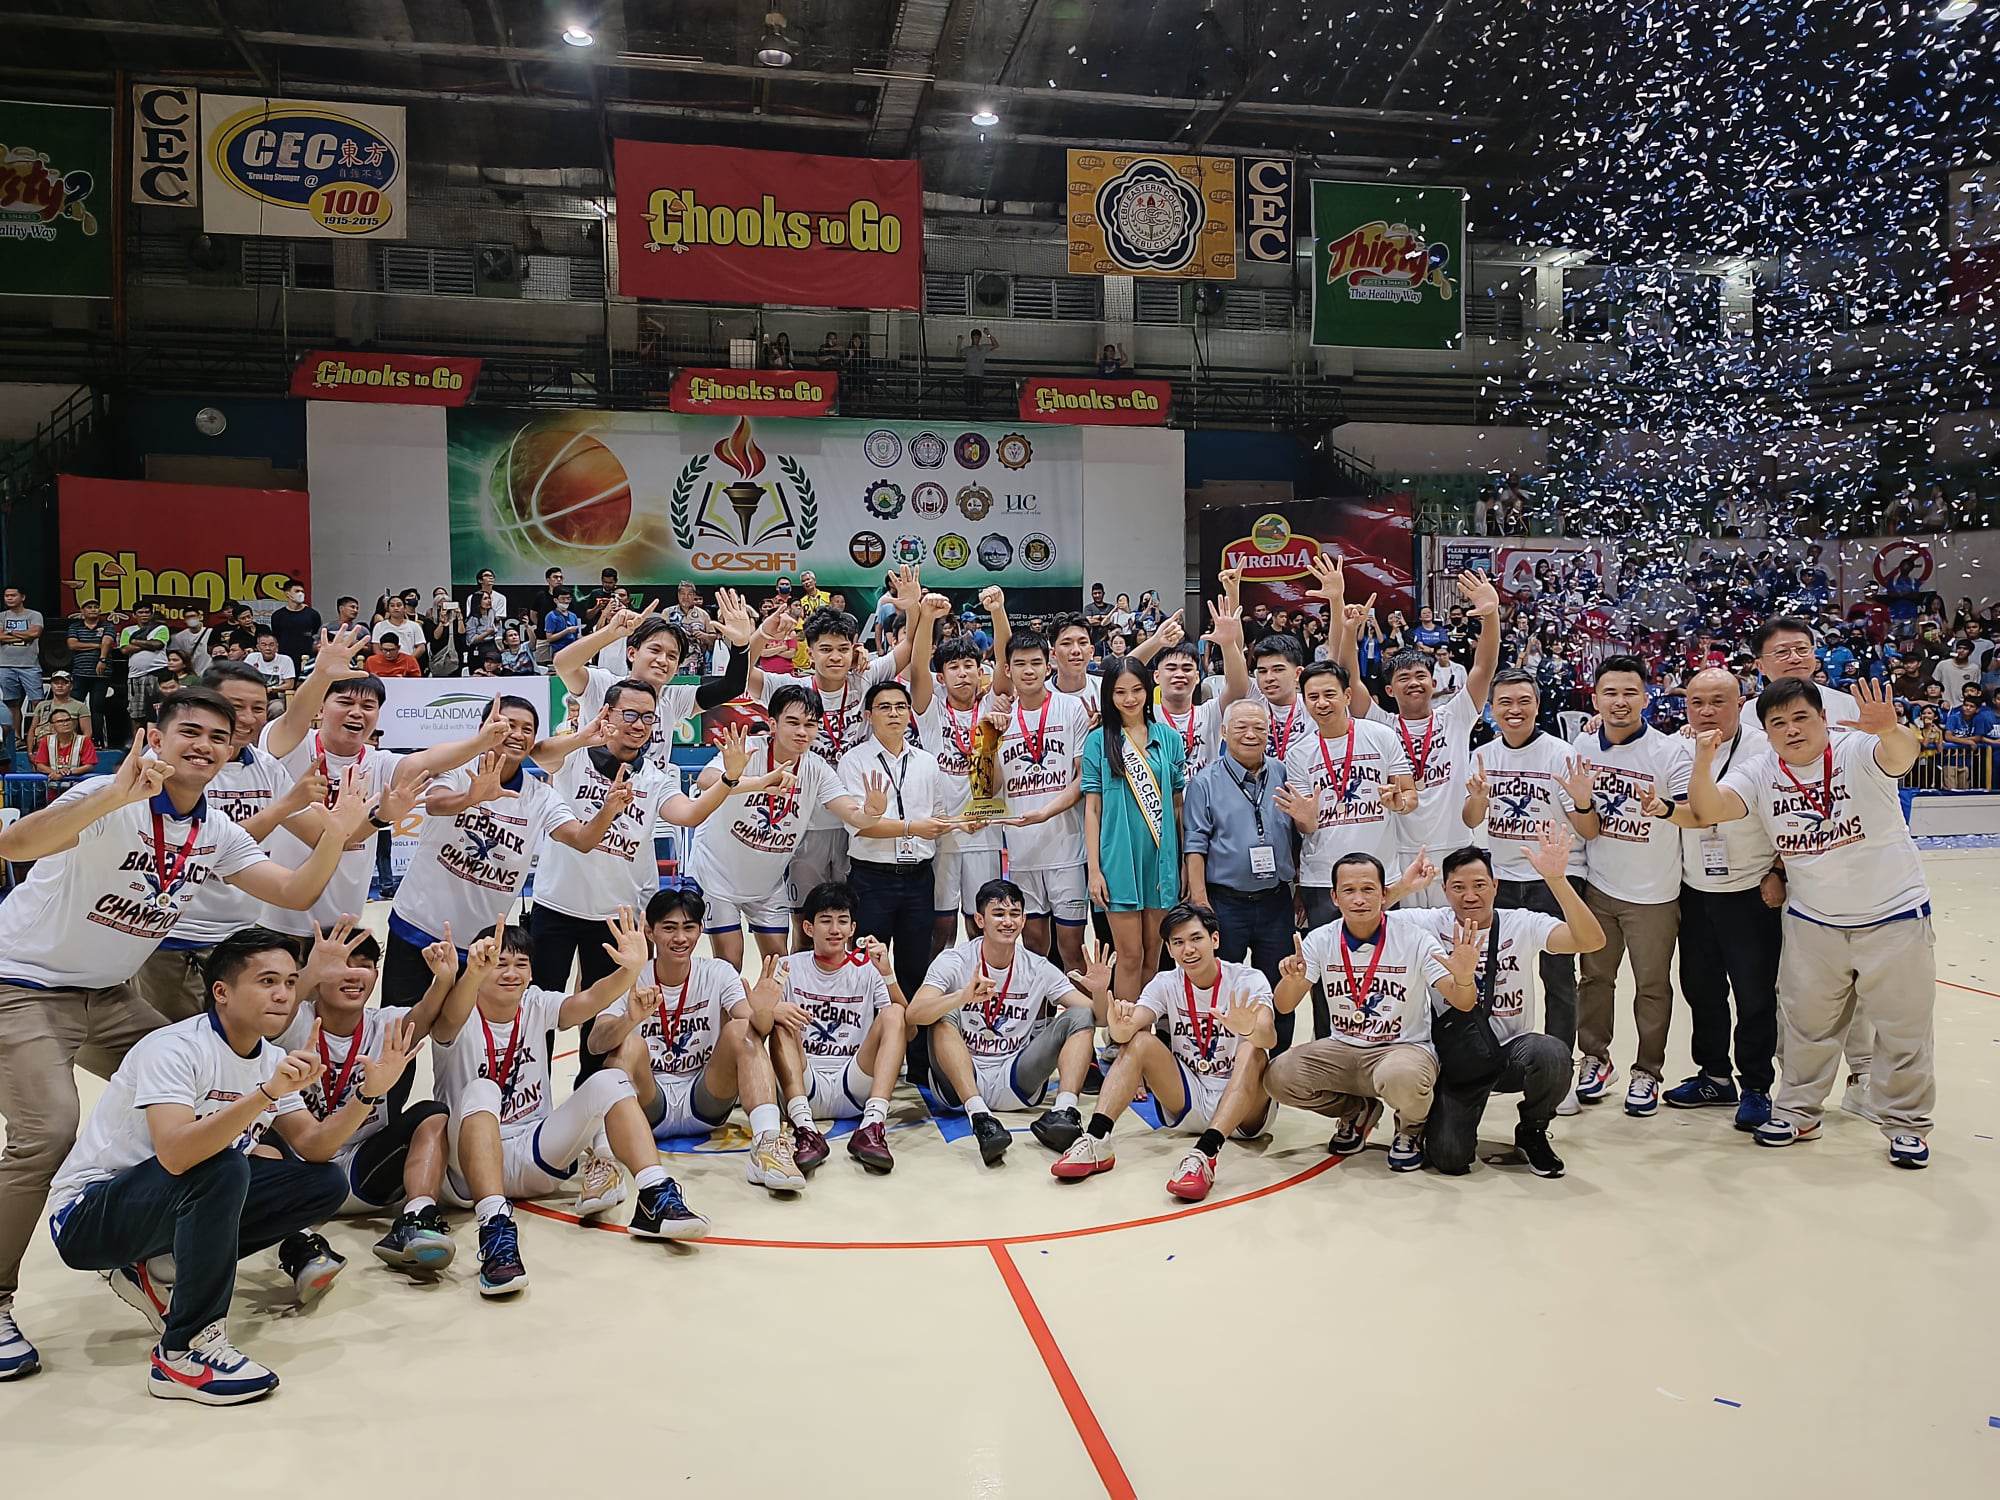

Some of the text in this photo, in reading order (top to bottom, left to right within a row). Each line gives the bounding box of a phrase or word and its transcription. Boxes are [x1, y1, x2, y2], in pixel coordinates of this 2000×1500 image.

[242, 130, 338, 170] CEC
[338, 138, 388, 168] 東方
[304, 175, 319, 188] @
[321, 189, 380, 216] 100
[1121, 183, 1182, 229] CEBU EASTERN COLLEGE
[29, 225, 57, 241] Way
[324, 216, 381, 226] 1915-2015
[648, 188, 901, 253] Chooks to Go
[1130, 235, 1172, 249] CEBU CITY
[1329, 231, 1428, 286] Thirsty
[1350, 288, 1422, 303] The Healthy Way
[317, 361, 463, 390] Chooks to Go
[690, 376, 822, 402] Chooks to Go
[1036, 387, 1159, 410] Chooks to Go
[1227, 548, 1311, 569] VIRGINIA
[75, 552, 293, 614] Chooks
[1007, 769, 1067, 792] CHAMPIONS
[1125, 752, 1148, 782] MISS
[1489, 777, 1551, 805] ACK2BACK
[1318, 800, 1384, 823] CHAPIONS
[440, 843, 520, 886] CHAMPIONS
